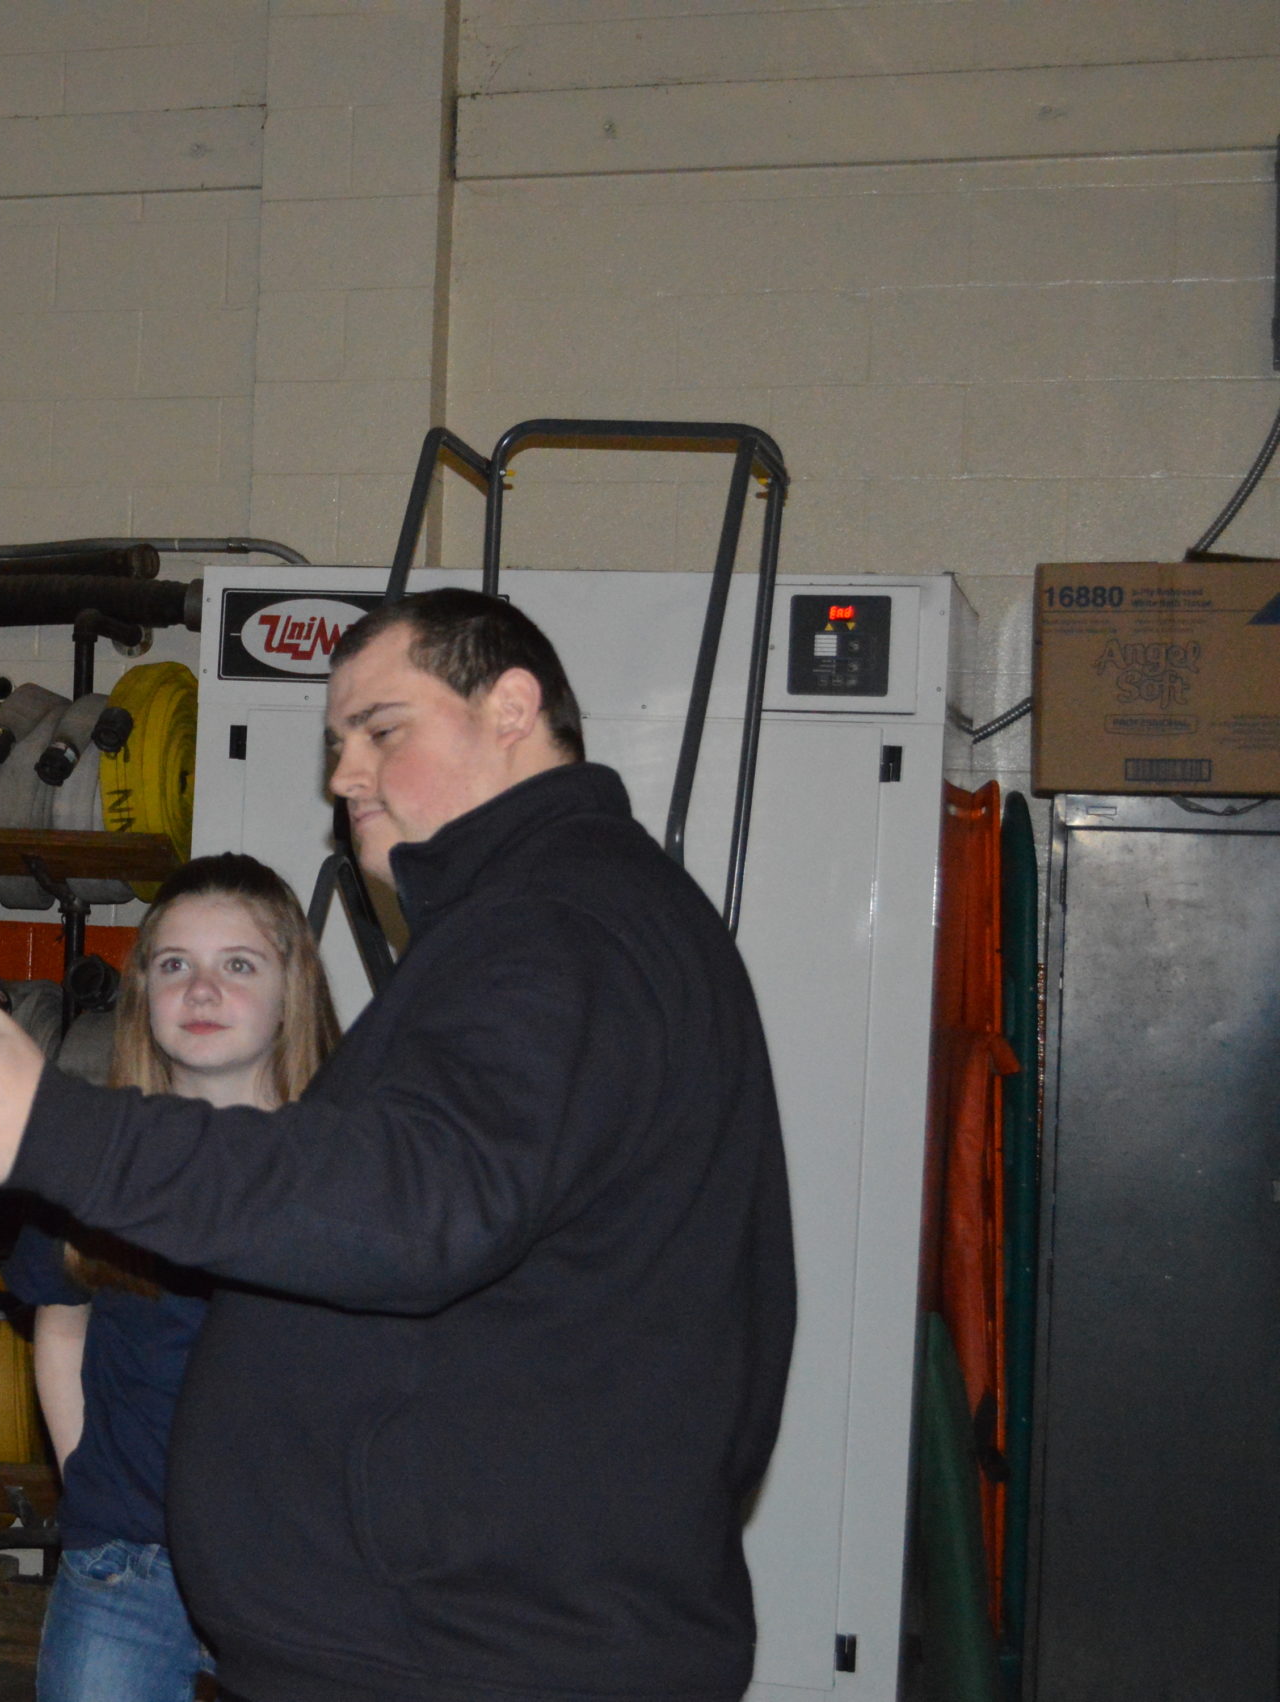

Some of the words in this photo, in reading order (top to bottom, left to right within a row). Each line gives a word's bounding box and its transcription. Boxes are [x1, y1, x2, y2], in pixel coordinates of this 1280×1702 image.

[1044, 586, 1124, 608] 16880
[1094, 638, 1202, 676] Angel
[1116, 669, 1191, 710] Soft
